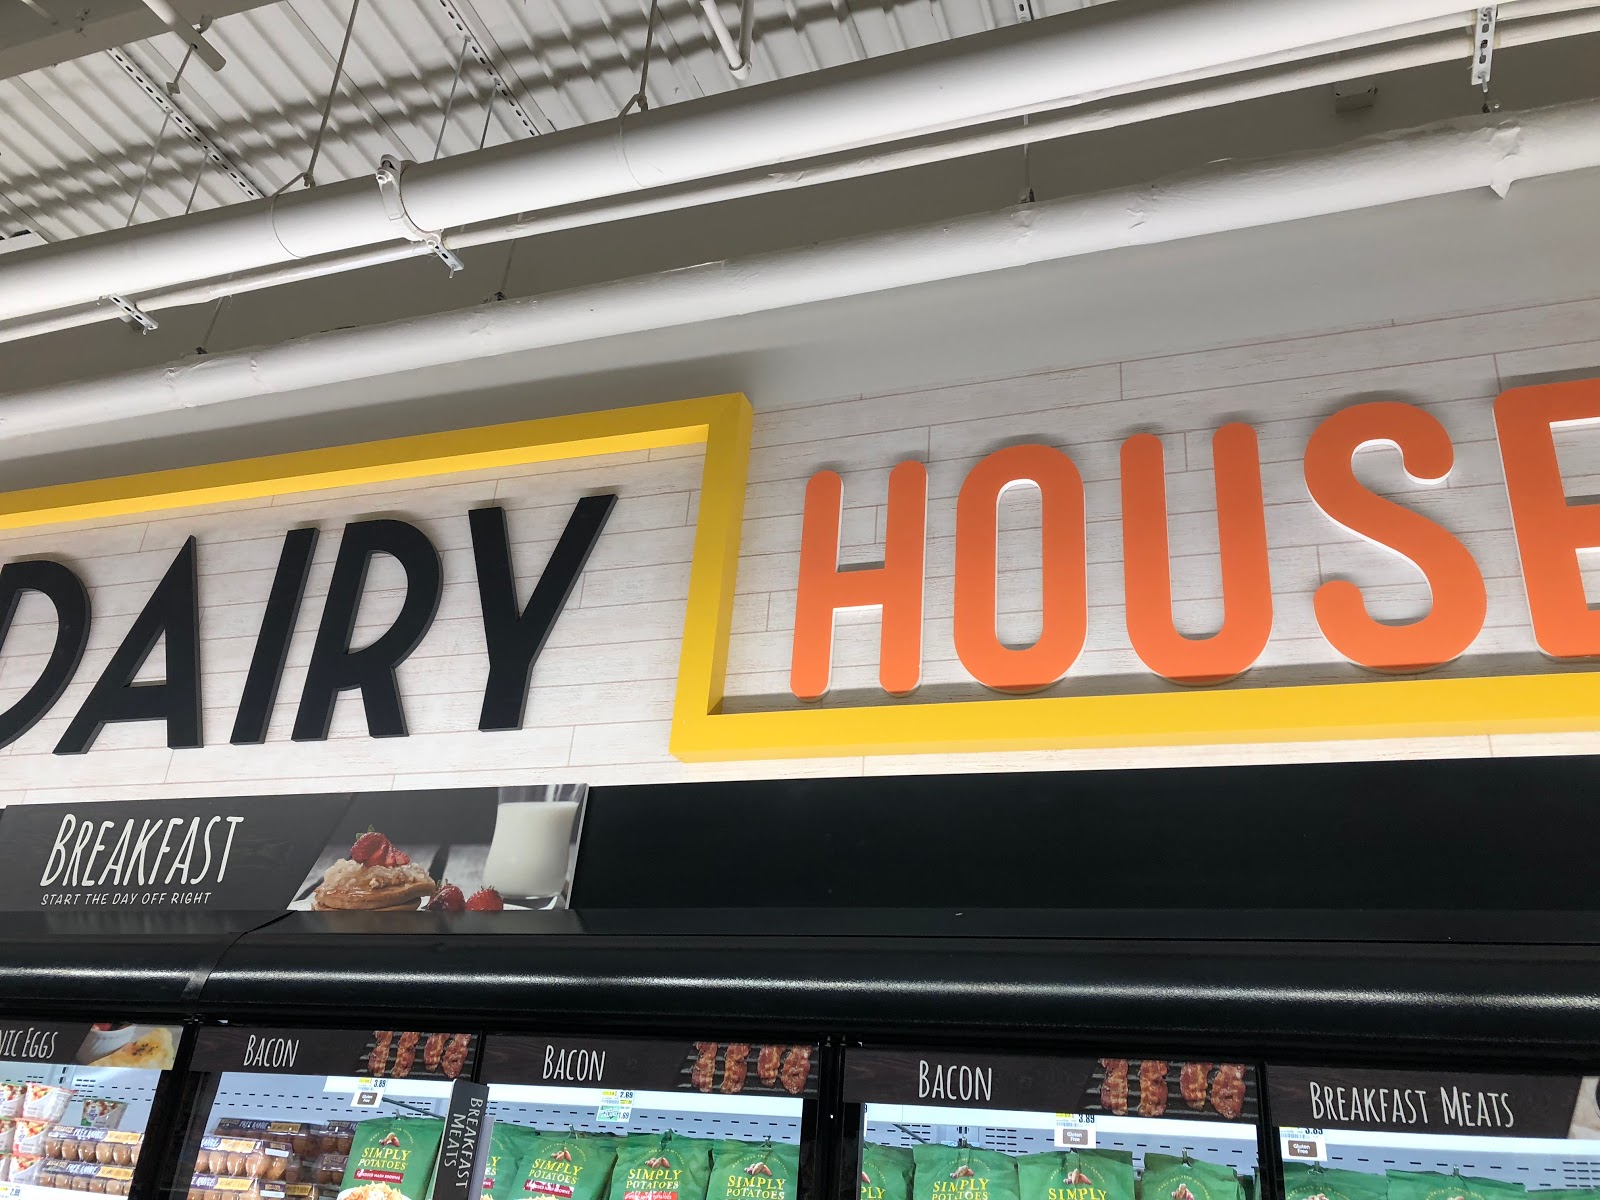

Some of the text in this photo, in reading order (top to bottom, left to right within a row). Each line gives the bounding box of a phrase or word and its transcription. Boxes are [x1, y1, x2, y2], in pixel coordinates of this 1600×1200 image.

[0, 377, 1600, 755] DAIRY HOUSE
[40, 814, 244, 887] BREAKFAST
[41, 891, 212, 906] START THE DAY OFF RIGHT
[243, 1034, 300, 1069] BACON
[542, 1045, 606, 1082] BACON
[918, 1059, 992, 1102] BACON
[1310, 1081, 1515, 1129] BREAKFAST MEATS
[444, 1113, 467, 1168] MEATS
[456, 1097, 484, 1189] BREAKFAST
[361, 1147, 412, 1161] SIMPLY
[357, 1158, 407, 1171] POTATOES
[532, 1158, 584, 1176] SIMPLY
[528, 1169, 578, 1185] POTATOES
[627, 1168, 683, 1181] SIMPLY
[625, 1180, 680, 1190] POTATOES
[727, 1175, 787, 1191] SIMPLY
[932, 1178, 990, 1193] SIMPLY
[725, 1187, 786, 1200] POTATOES
[1048, 1187, 1107, 1200] SIMPLY
